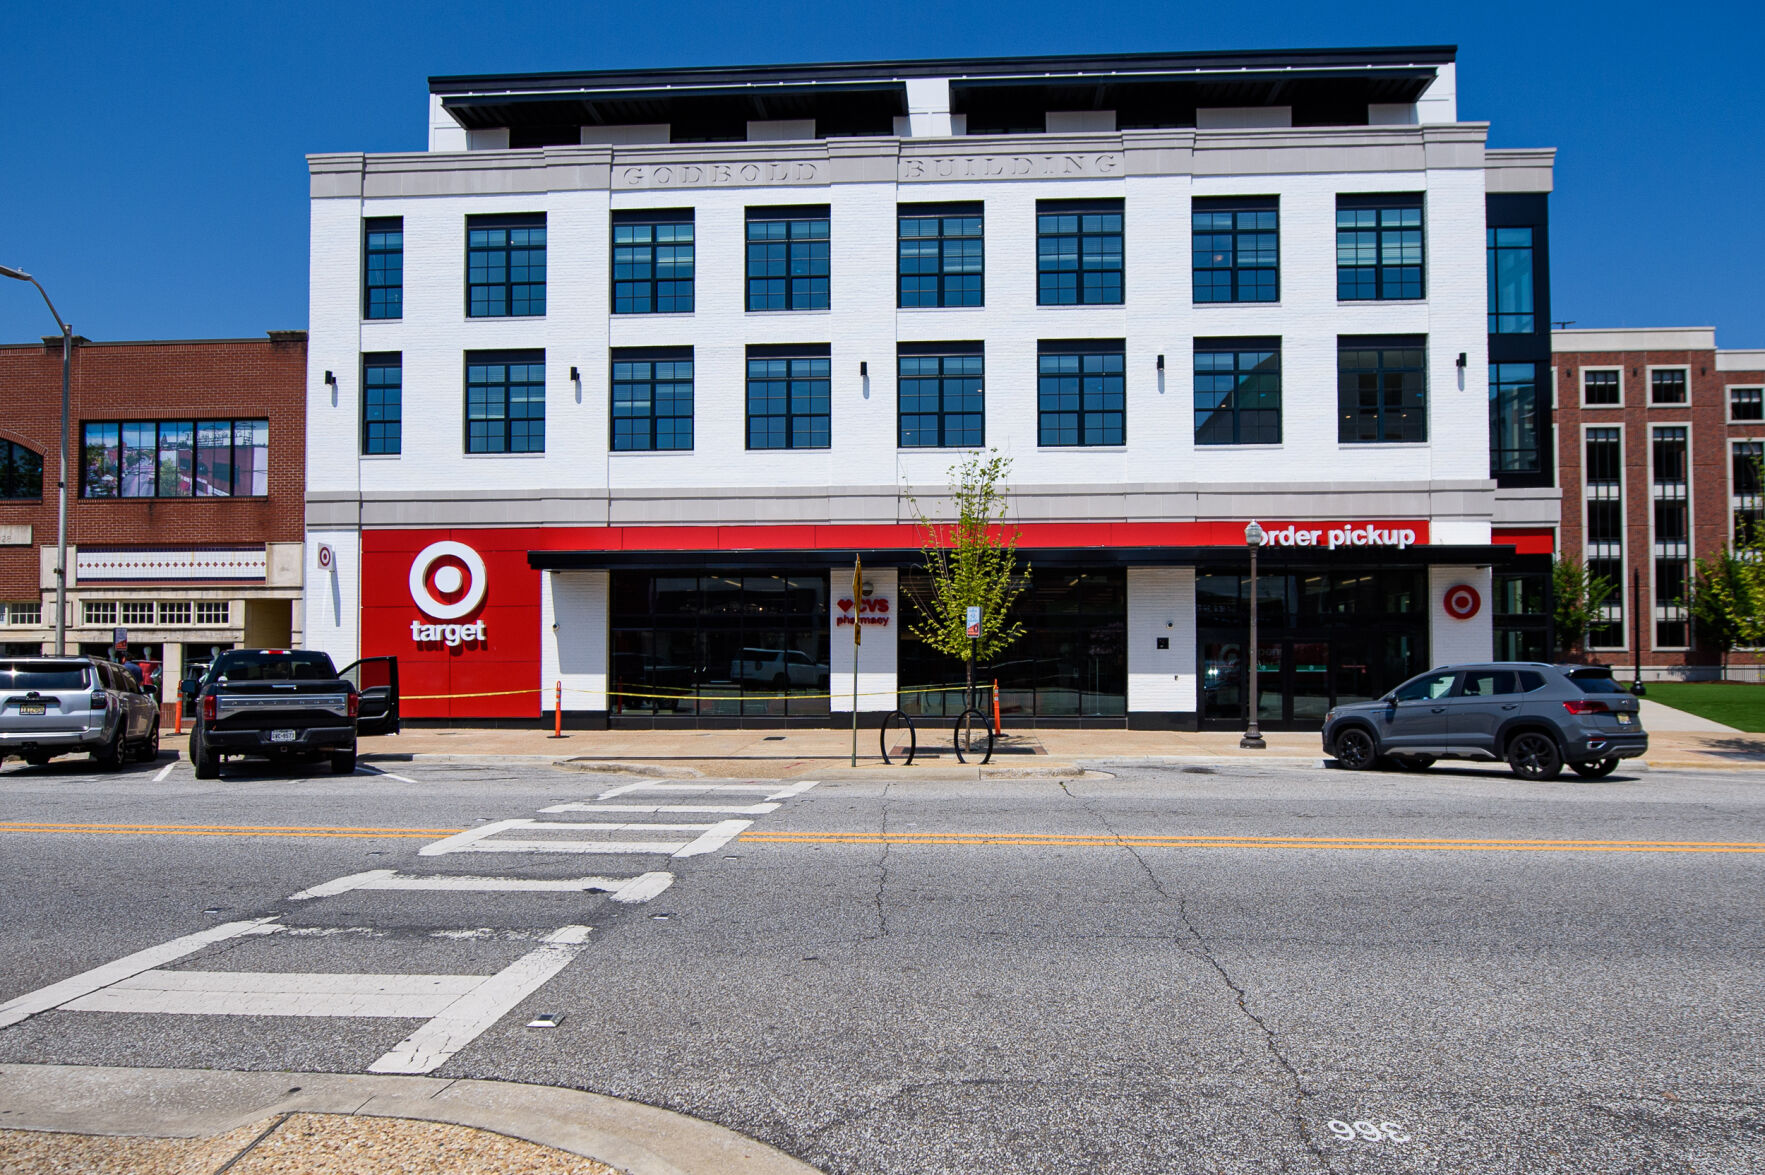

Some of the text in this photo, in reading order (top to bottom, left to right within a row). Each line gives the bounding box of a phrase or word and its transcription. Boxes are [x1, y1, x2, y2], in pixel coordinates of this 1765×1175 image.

[623, 155, 1117, 186] GODBOLD BUILDING
[1328, 524, 1416, 550] pickup
[409, 619, 487, 647] target
[836, 614, 890, 627] phamacy
